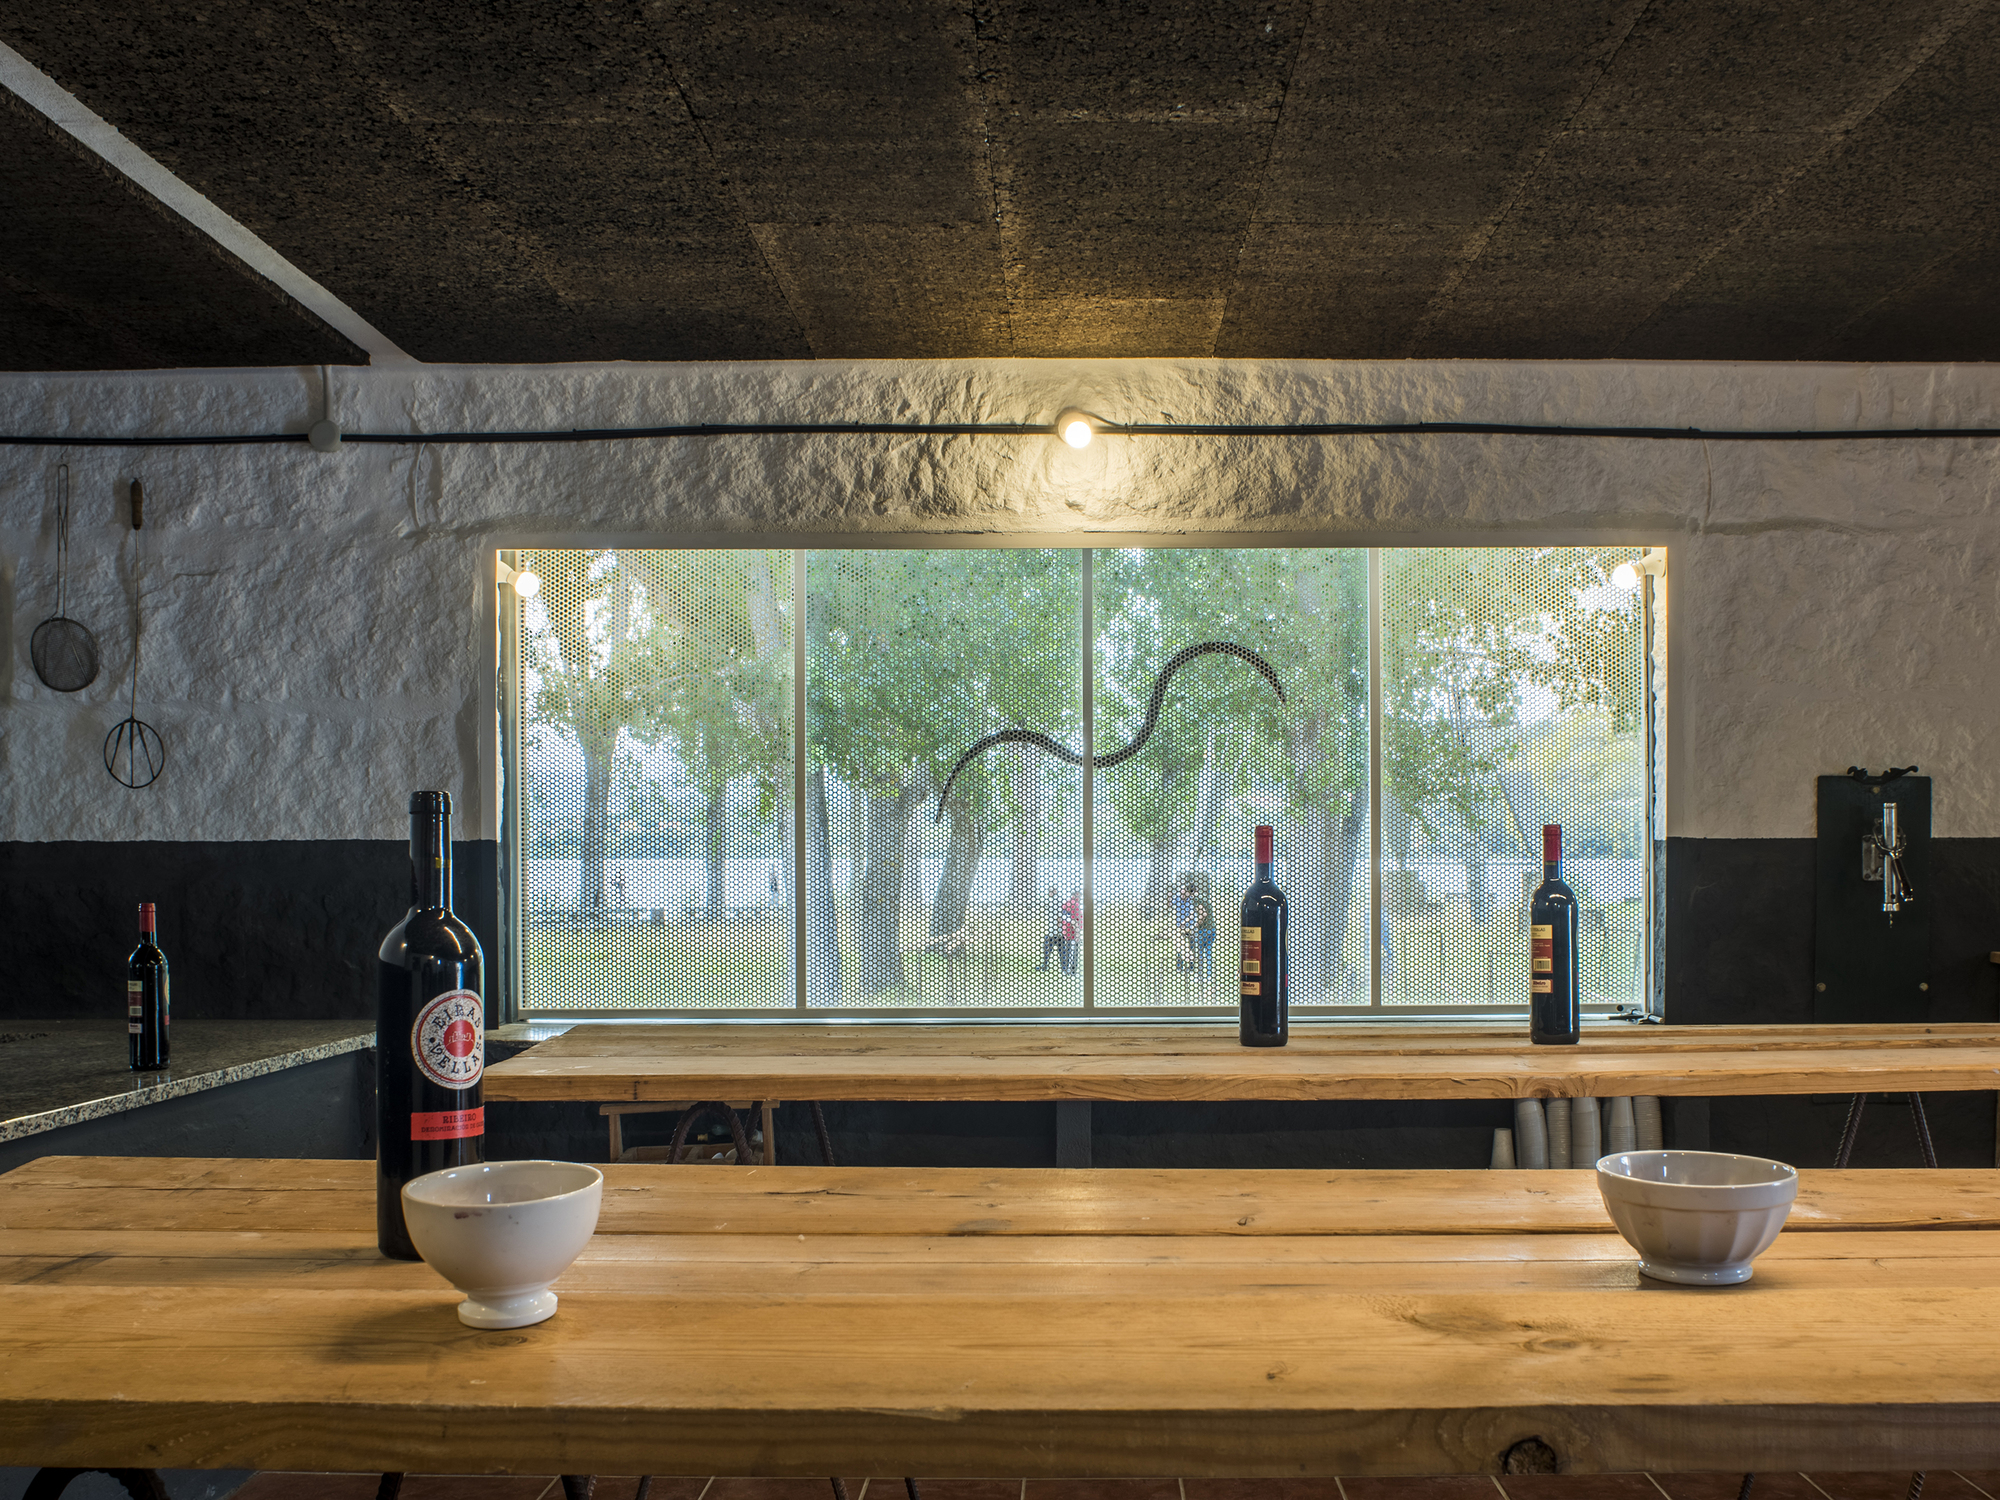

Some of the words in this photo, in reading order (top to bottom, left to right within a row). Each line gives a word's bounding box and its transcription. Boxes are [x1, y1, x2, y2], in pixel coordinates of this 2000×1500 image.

[432, 1004, 481, 1029] EIRAS
[430, 1042, 481, 1074] VELLAS
[443, 1113, 476, 1124] RIBEIRO
